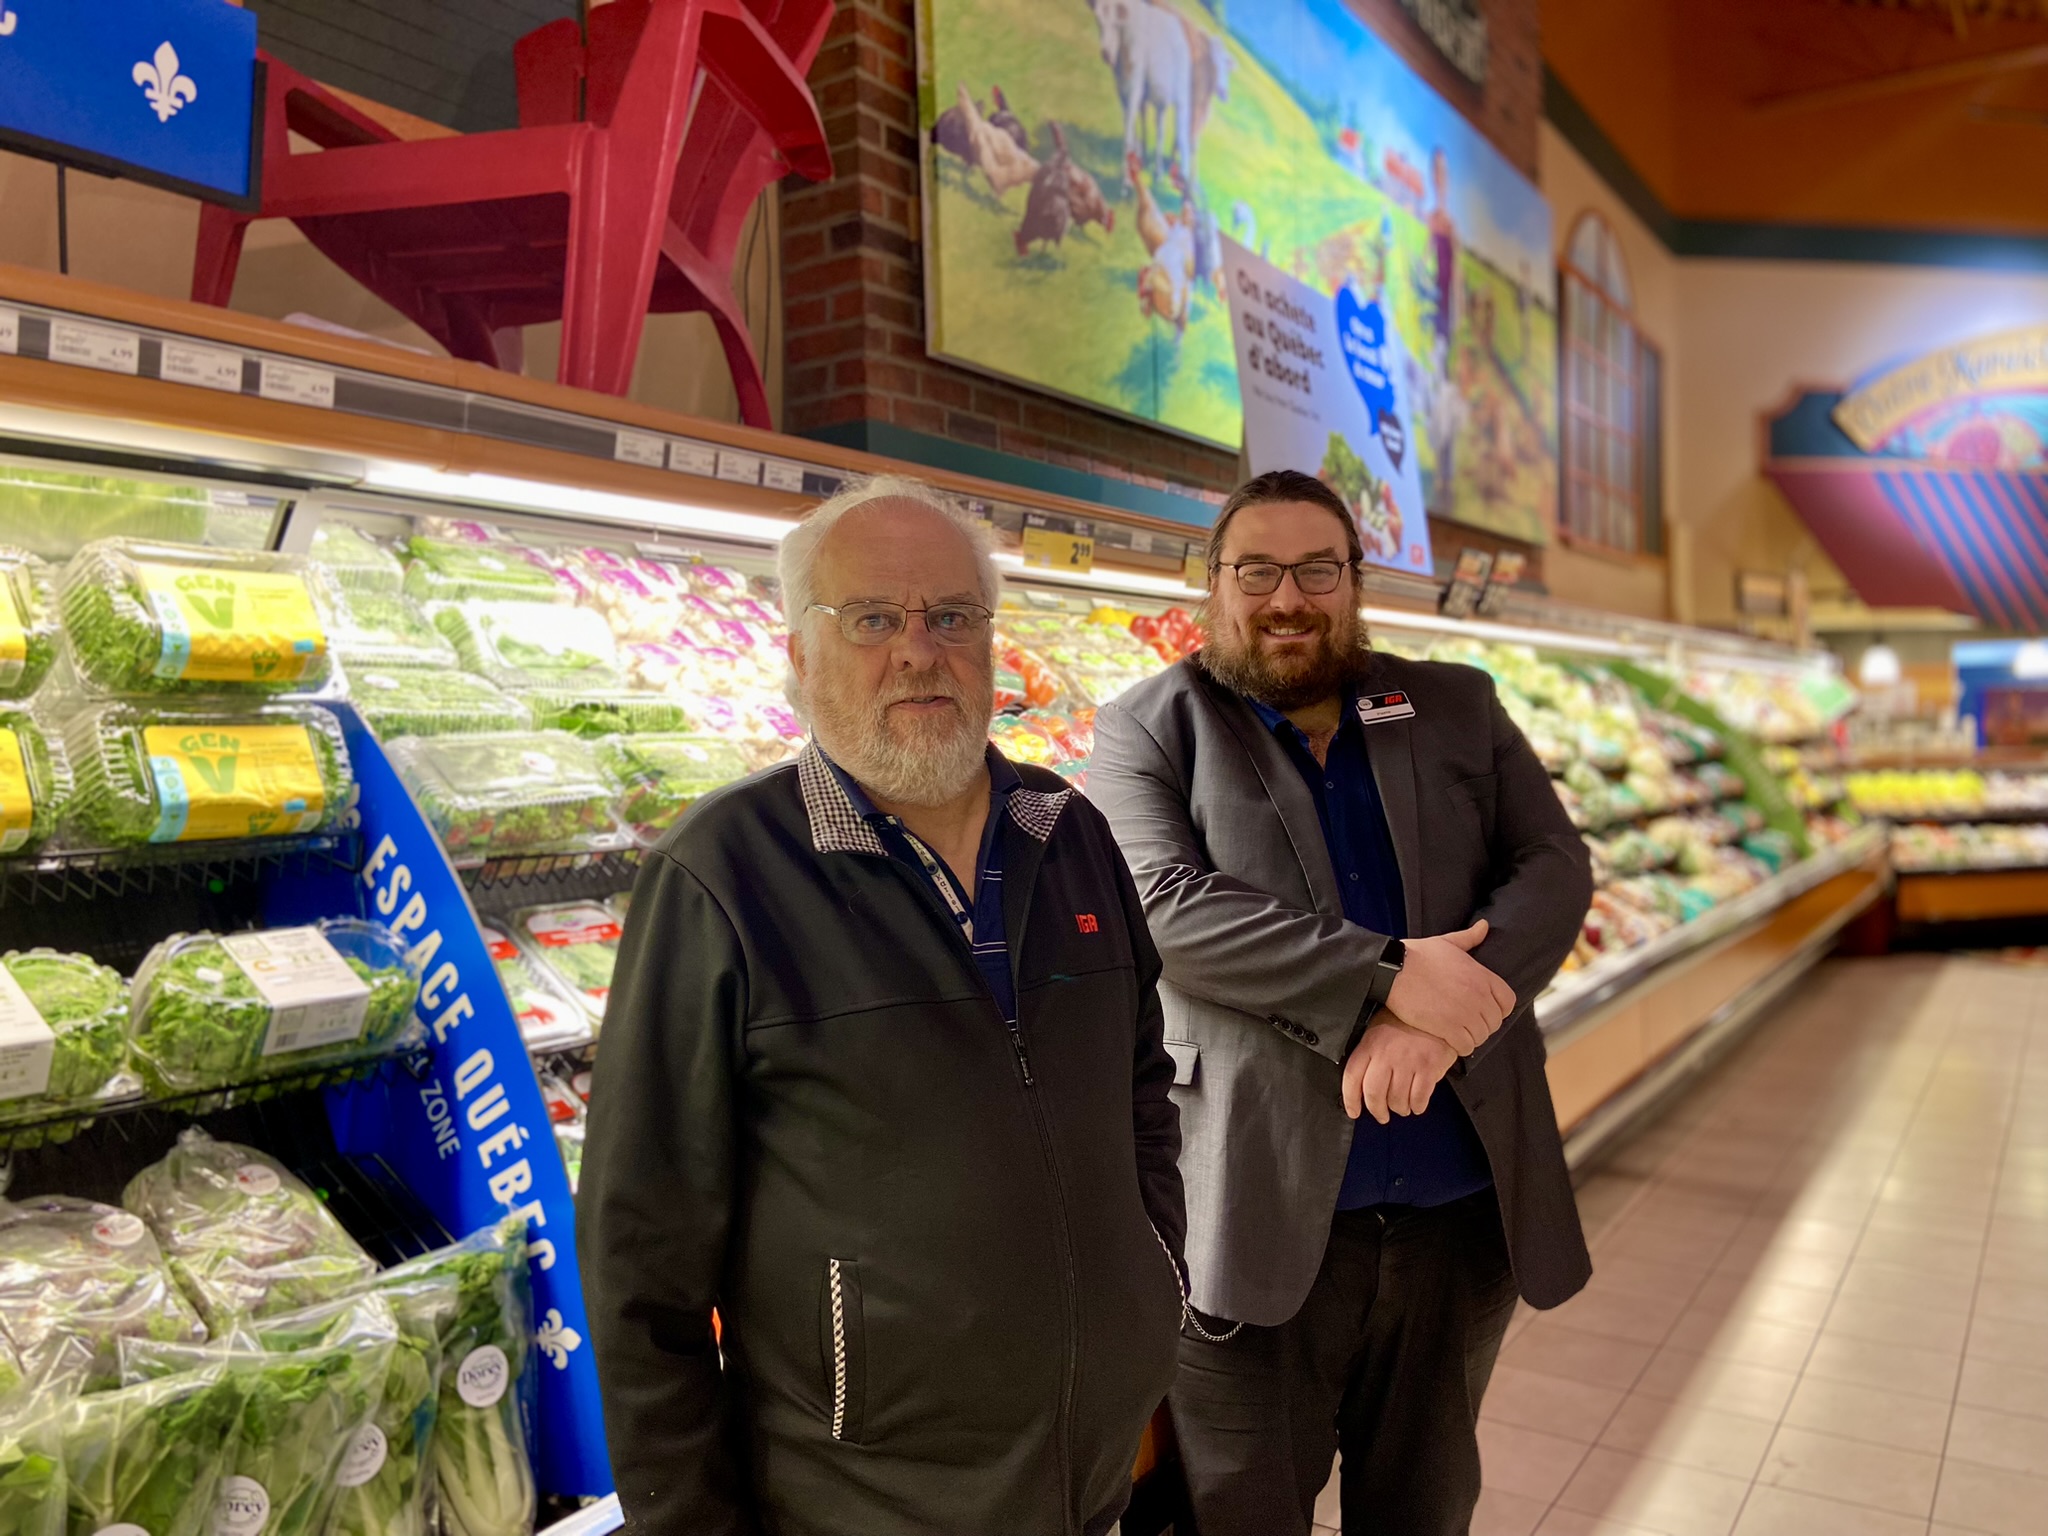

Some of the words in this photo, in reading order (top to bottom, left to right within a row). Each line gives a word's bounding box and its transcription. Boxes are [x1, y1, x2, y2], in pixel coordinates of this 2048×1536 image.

[175, 574, 236, 595] GEN
[1384, 694, 1403, 705] IGA
[178, 732, 241, 755] GEN
[1075, 914, 1099, 934] IGA
[362, 834, 475, 1044] ESPACE
[419, 1078, 462, 1160] ZONE
